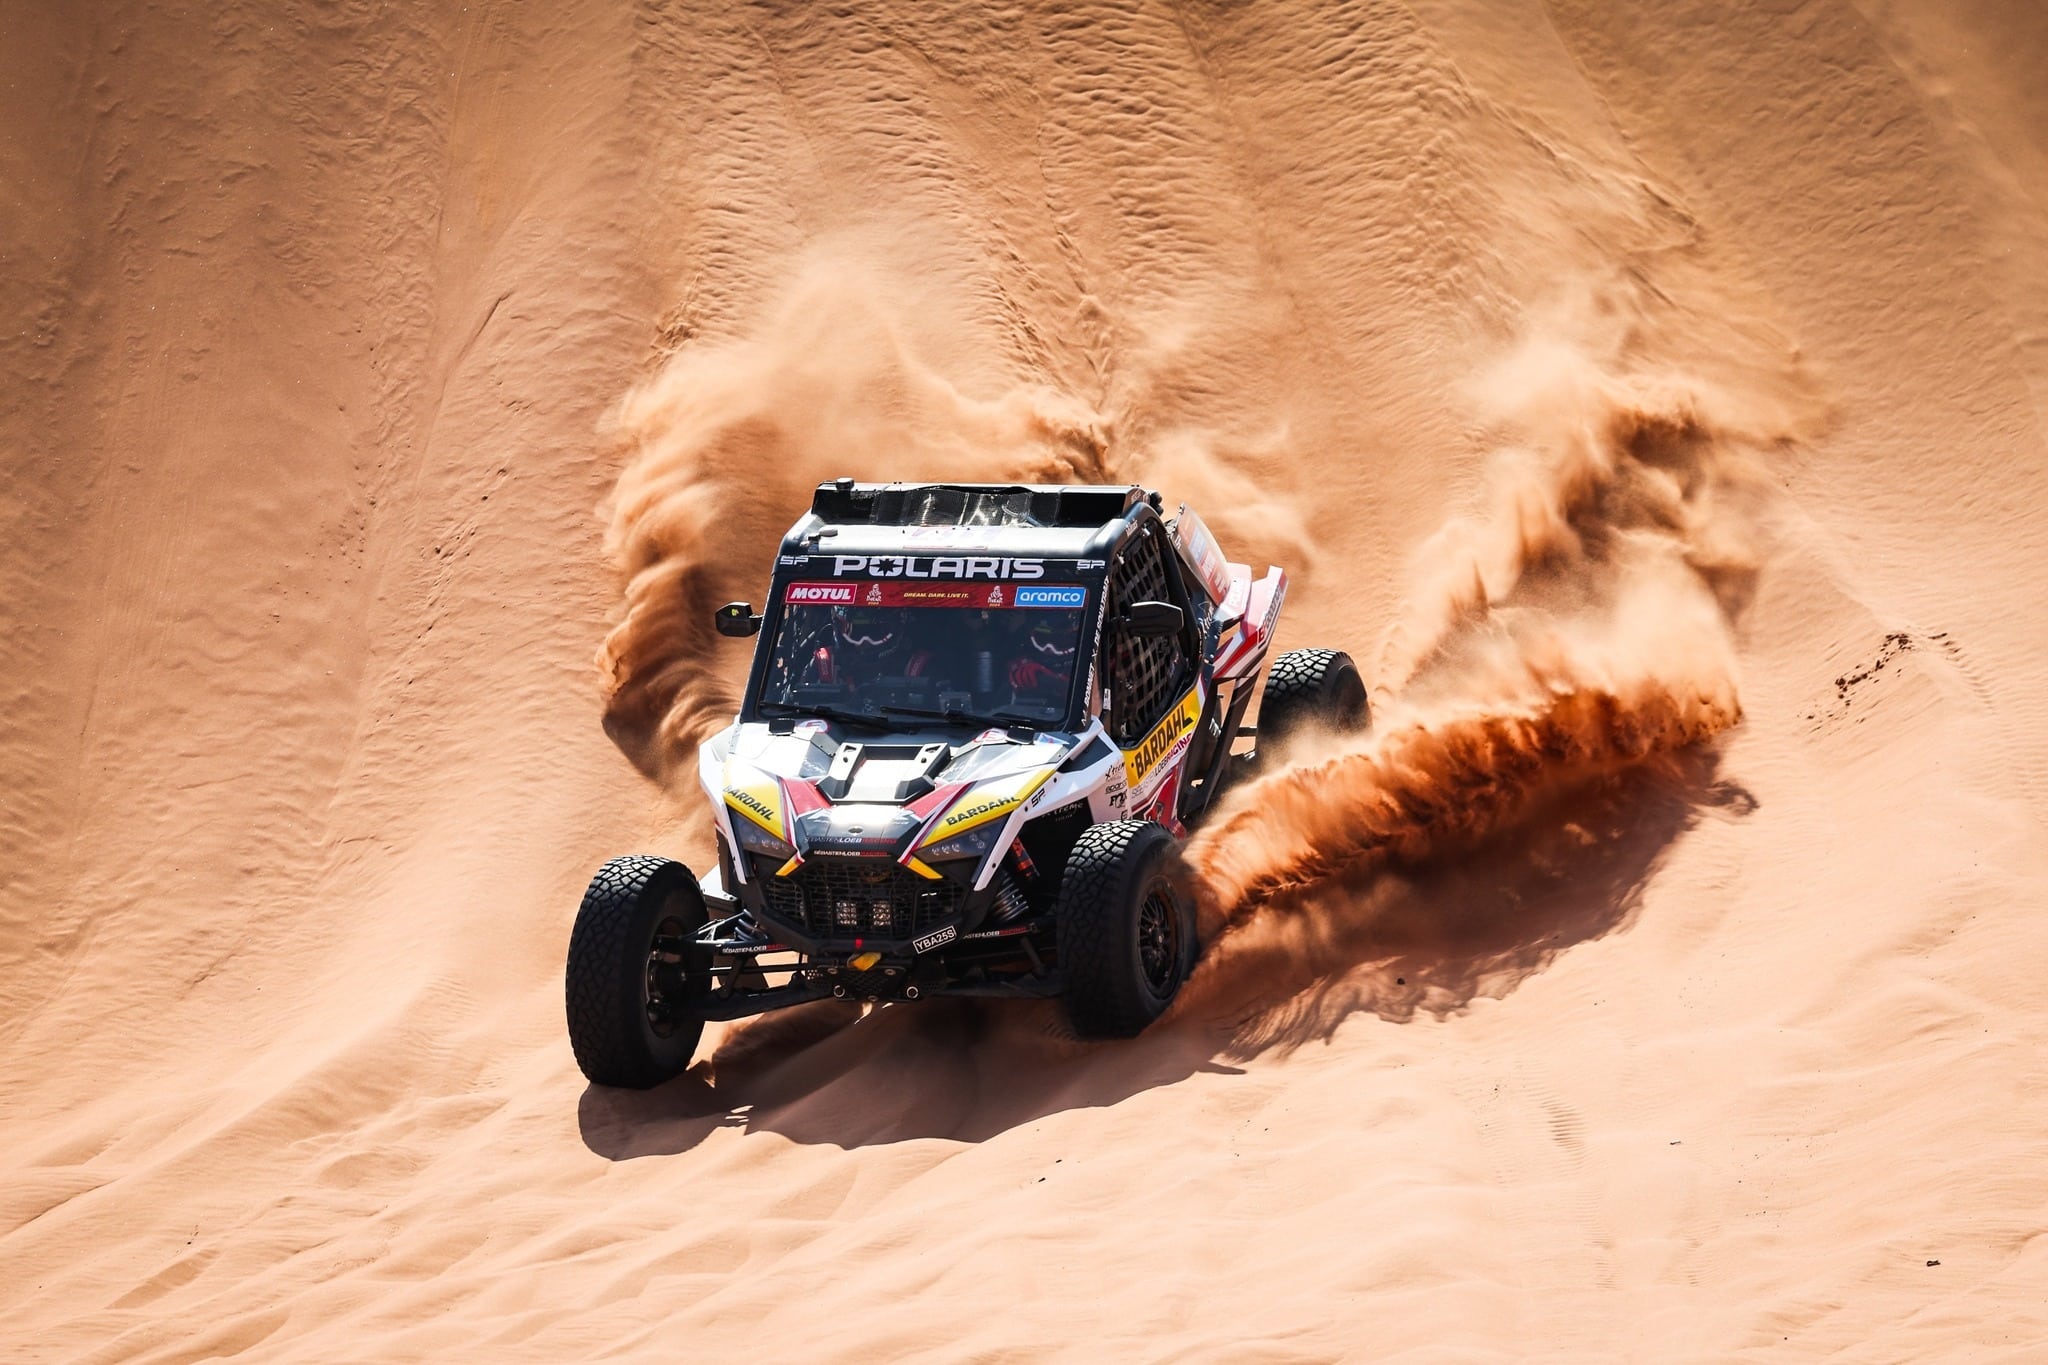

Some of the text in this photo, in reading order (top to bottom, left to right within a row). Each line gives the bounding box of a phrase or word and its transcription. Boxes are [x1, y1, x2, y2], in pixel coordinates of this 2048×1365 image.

[780, 555, 809, 565] SP
[833, 555, 1045, 579] POLARIS
[1076, 560, 1105, 570] SP
[790, 587, 852, 600] MOTUL
[1020, 592, 1081, 602] aramco
[1133, 704, 1194, 780] BARDAHL
[946, 796, 1021, 826] BARDAHL
[916, 929, 955, 950] YBA25S
